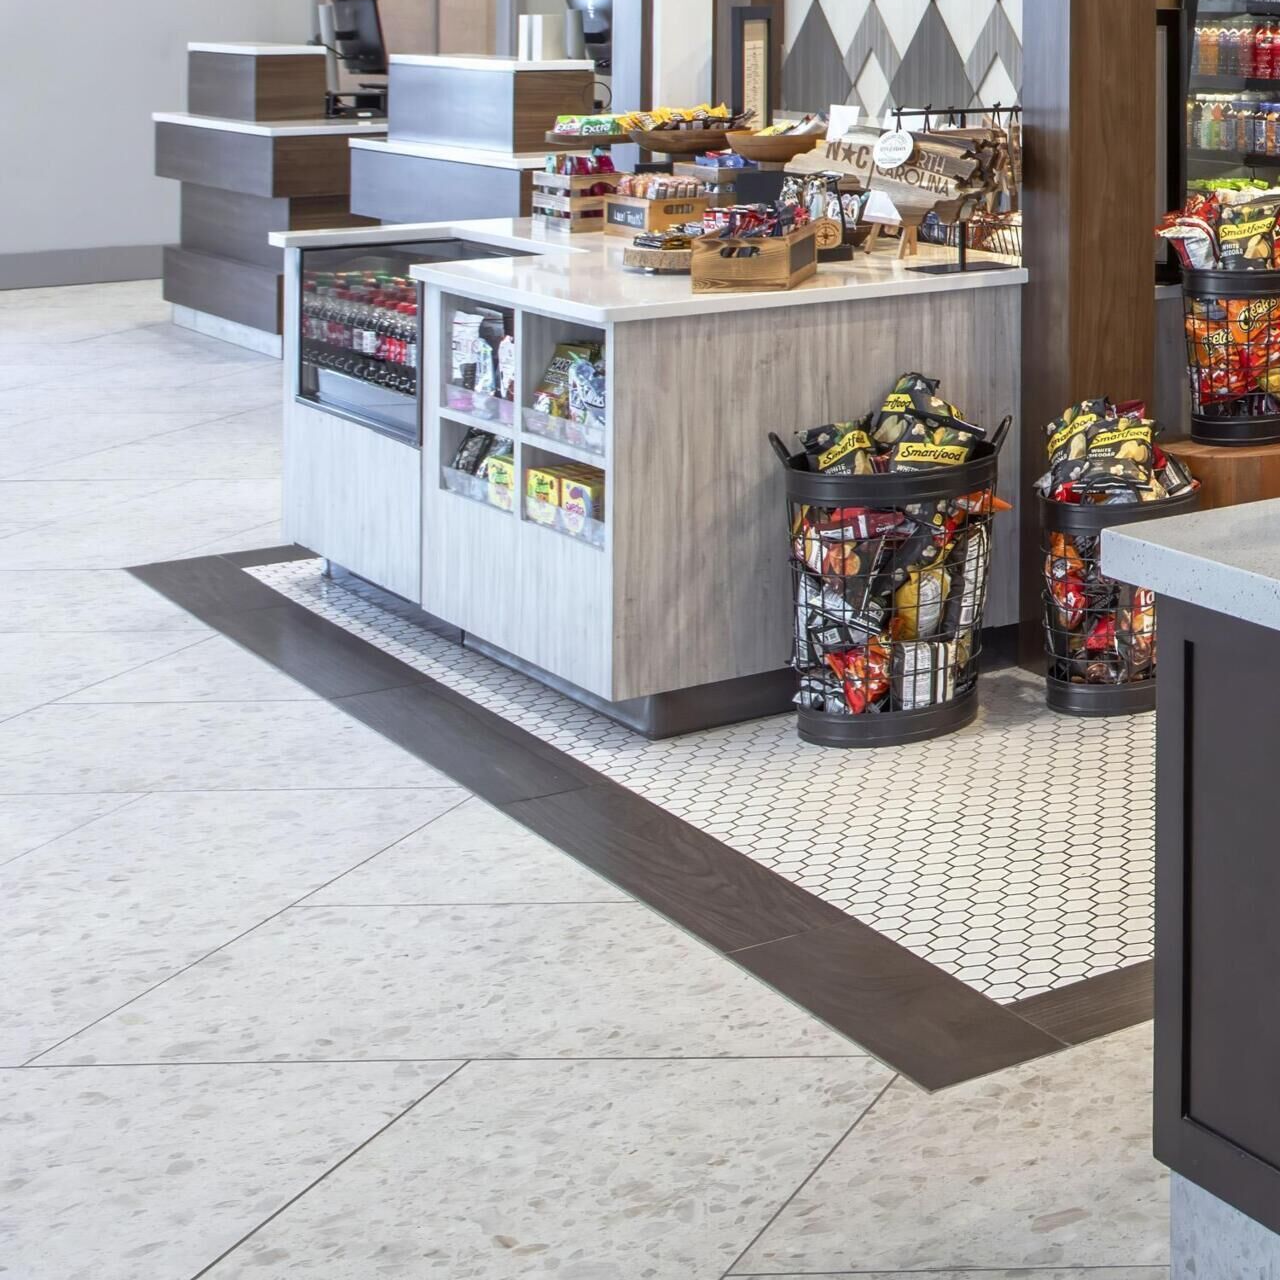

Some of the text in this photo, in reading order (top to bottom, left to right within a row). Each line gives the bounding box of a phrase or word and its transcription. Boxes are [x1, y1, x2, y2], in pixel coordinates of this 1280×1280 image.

[583, 122, 611, 134] Extra
[876, 164, 949, 197] CAROLINA
[1220, 220, 1273, 238] Smartfood
[1094, 429, 1149, 444] Smartfood
[901, 444, 963, 461] Smartfood
